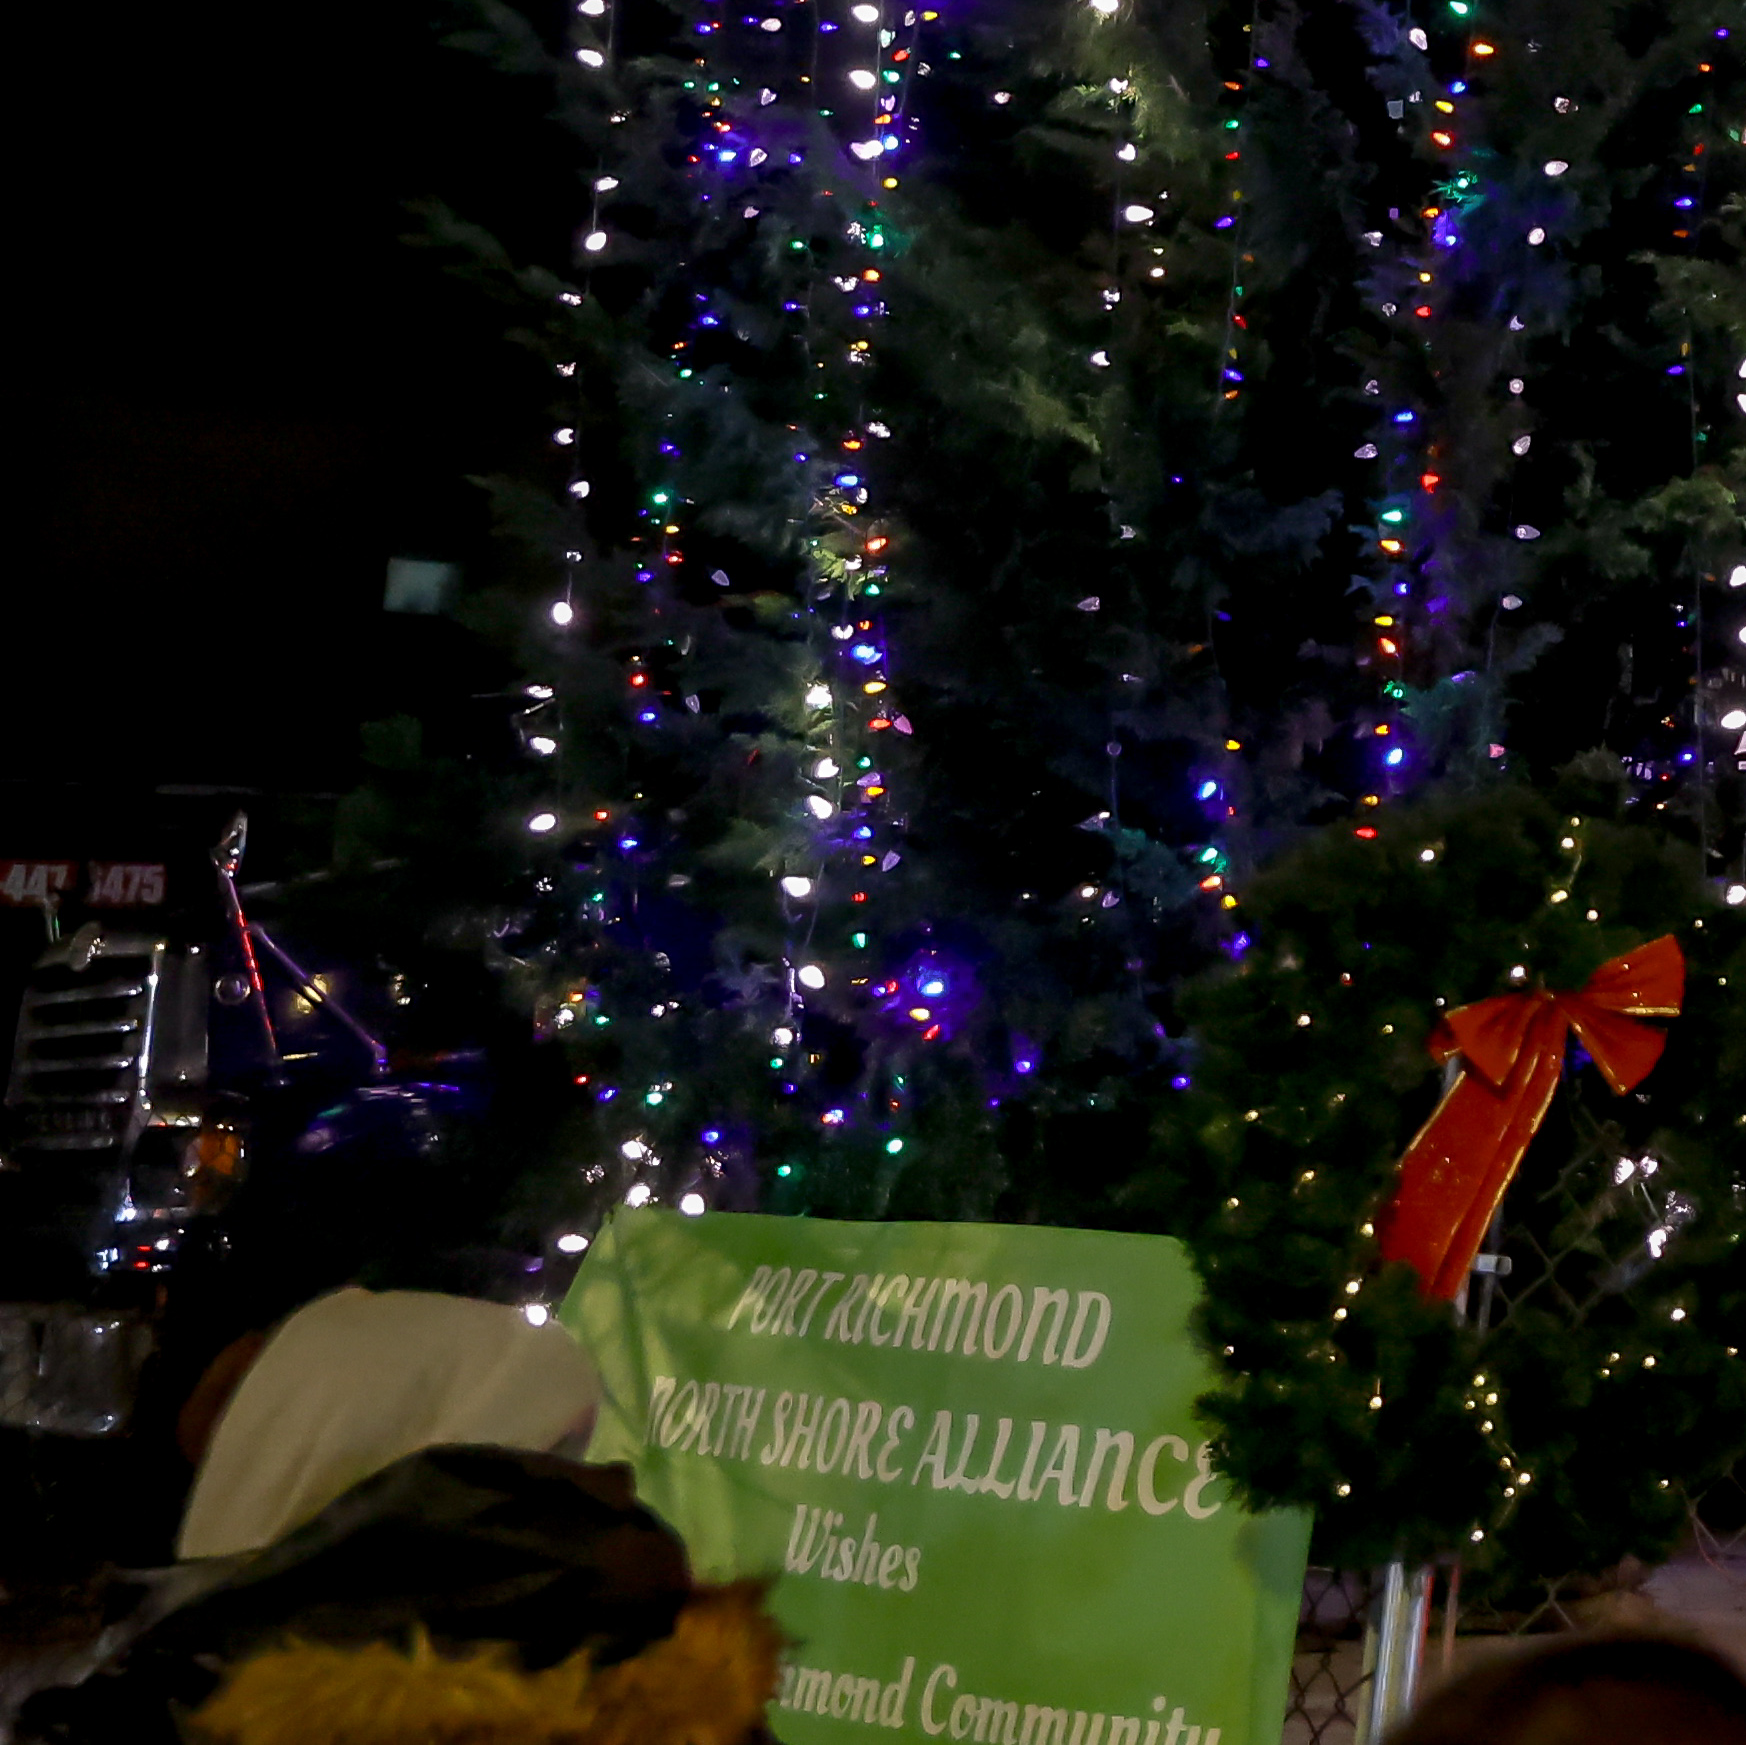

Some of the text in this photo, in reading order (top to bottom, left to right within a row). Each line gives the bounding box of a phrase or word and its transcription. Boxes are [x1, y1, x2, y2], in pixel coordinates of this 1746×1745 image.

[728, 1265, 1112, 1370] PORT RICHMOND
[643, 1375, 1223, 1520] NORTH SHORE ALLIANCE
[785, 1503, 922, 1593] Wishes
